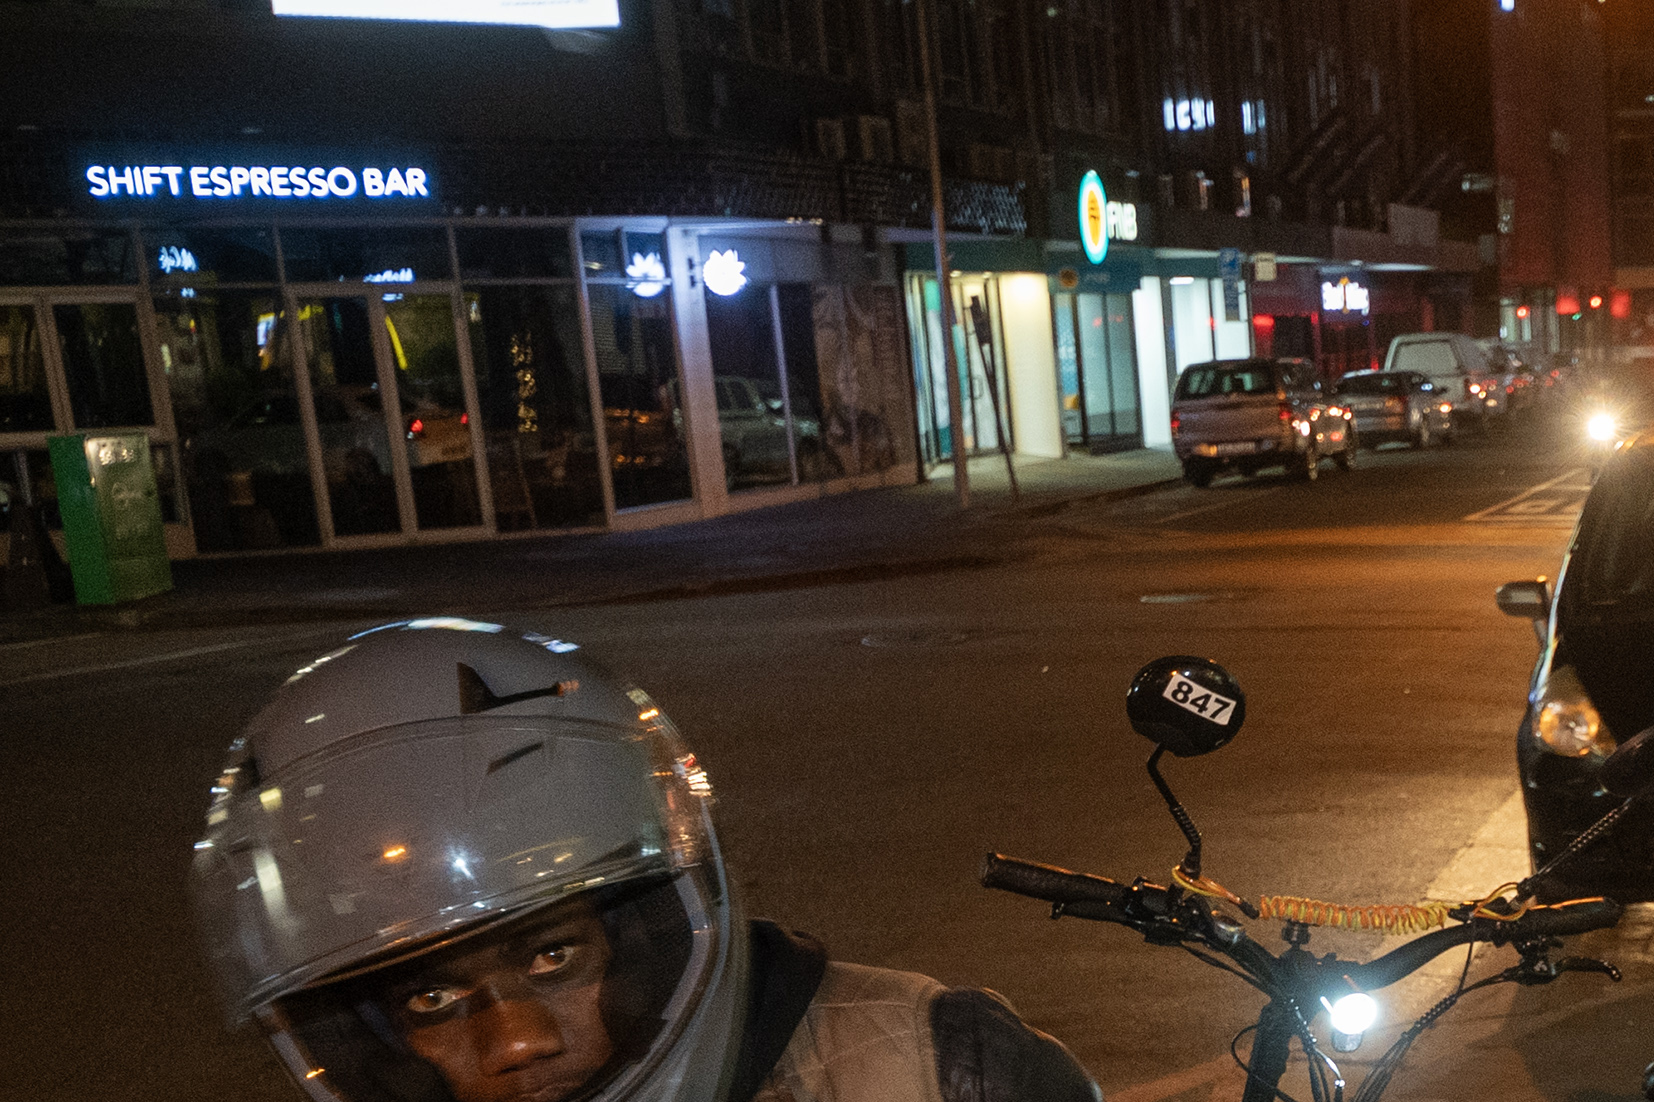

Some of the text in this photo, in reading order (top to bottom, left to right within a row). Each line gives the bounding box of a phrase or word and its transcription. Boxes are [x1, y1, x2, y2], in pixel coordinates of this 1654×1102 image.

[86, 165, 429, 198] SHIFT ESPRESSO BAR
[1171, 681, 1231, 720] 847
